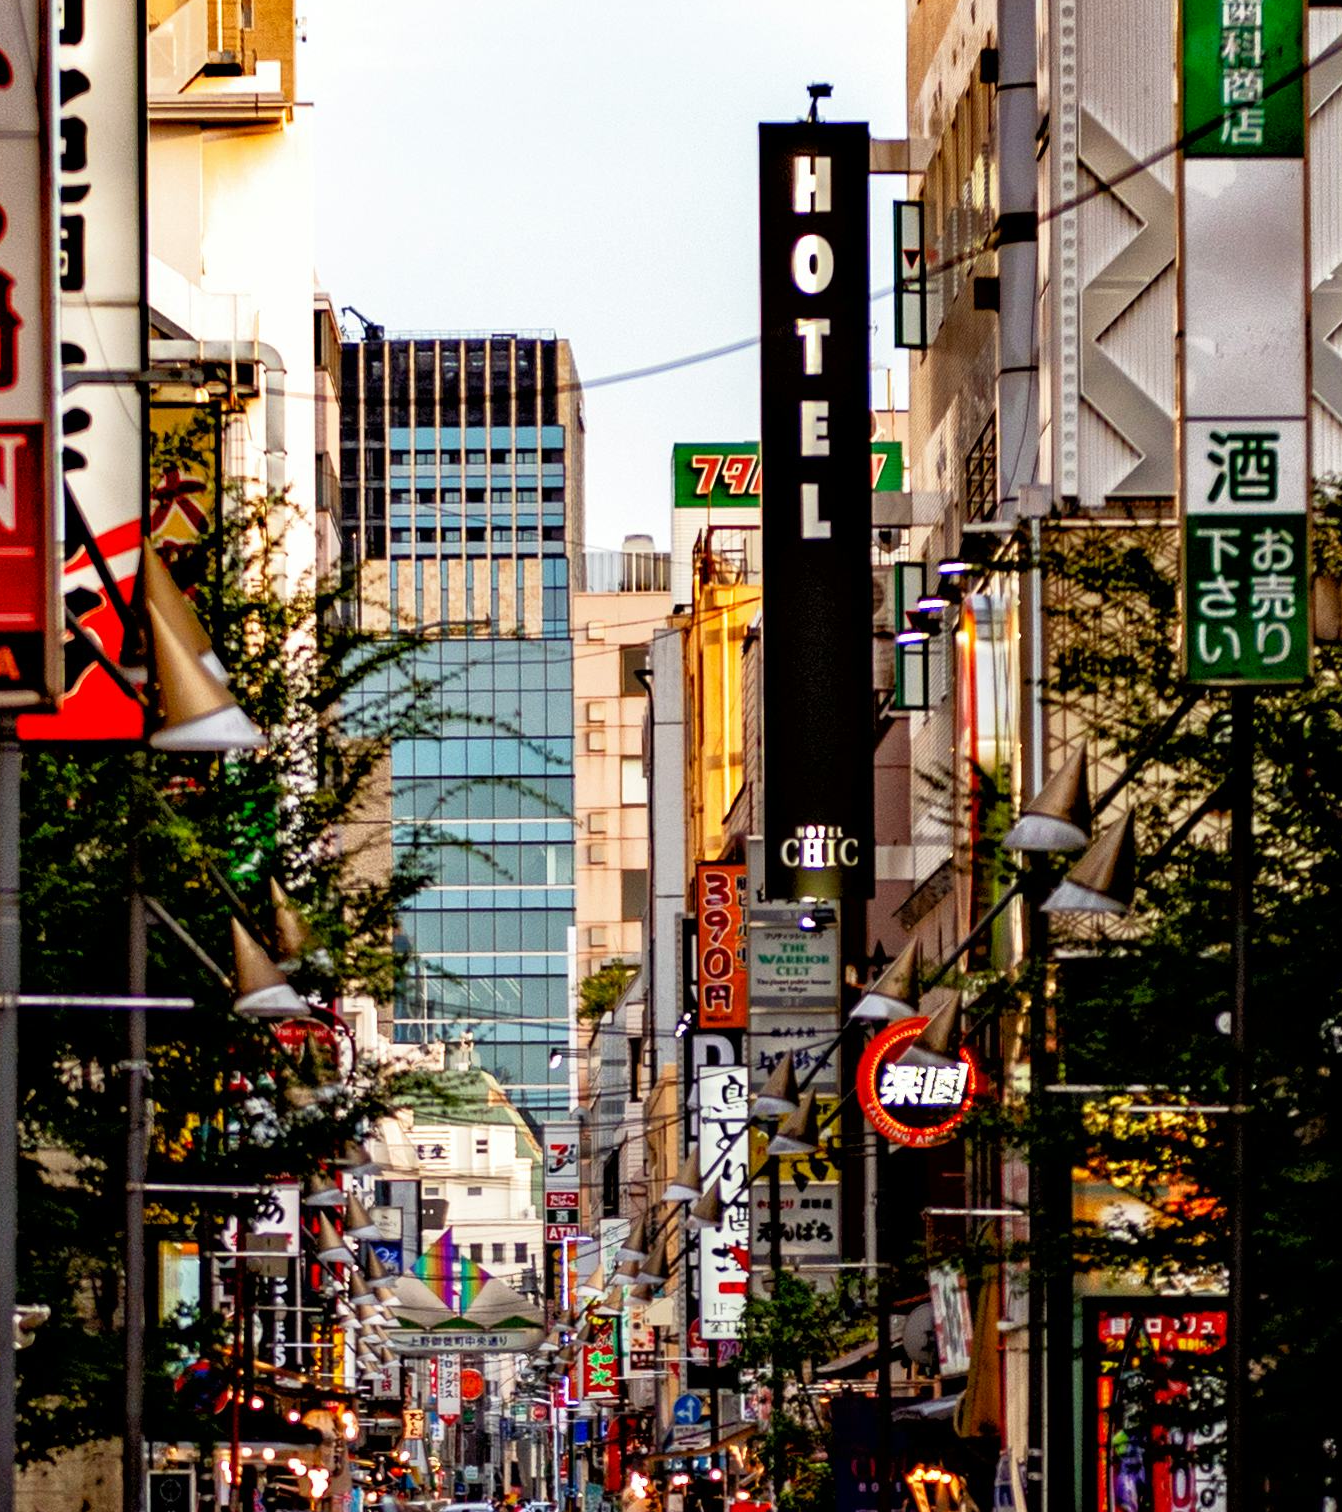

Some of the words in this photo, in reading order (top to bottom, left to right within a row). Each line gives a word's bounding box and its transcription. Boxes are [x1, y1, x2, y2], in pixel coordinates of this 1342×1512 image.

[791, 155, 835, 540] HOTEL
[1207, 430, 1281, 506] 酒
[1195, 528, 1241, 666] 下さい
[1249, 528, 1296, 666] お売り
[795, 825, 844, 839] HOTEL
[780, 838, 859, 868] CHIC
[780, 942, 808, 953] THE
[758, 954, 830, 965] WARRIOR
[879, 1061, 969, 1106] 楽園
[550, 1194, 576, 1207] たばこ
[549, 1226, 577, 1240] ATM
[409, 1336, 508, 1346] 上野御徒町中央通り
